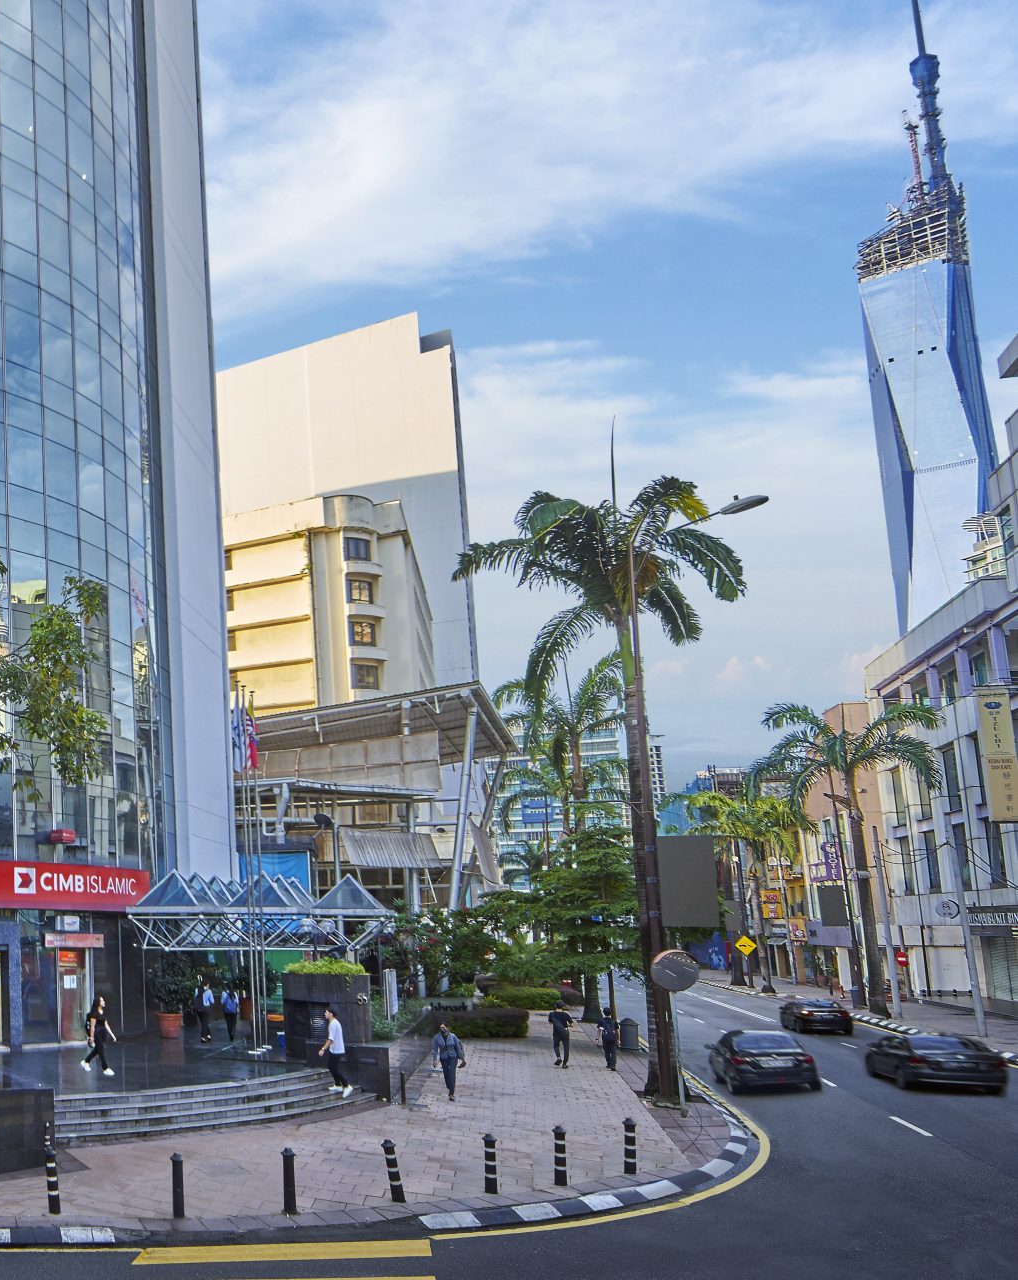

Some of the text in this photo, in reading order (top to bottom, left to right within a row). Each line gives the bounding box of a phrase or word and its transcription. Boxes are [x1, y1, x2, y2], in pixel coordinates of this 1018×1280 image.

[828, 852, 838, 880] HOTEL
[40, 872, 137, 896] CIMB ISLAMIC
[357, 993, 368, 1005] 55
